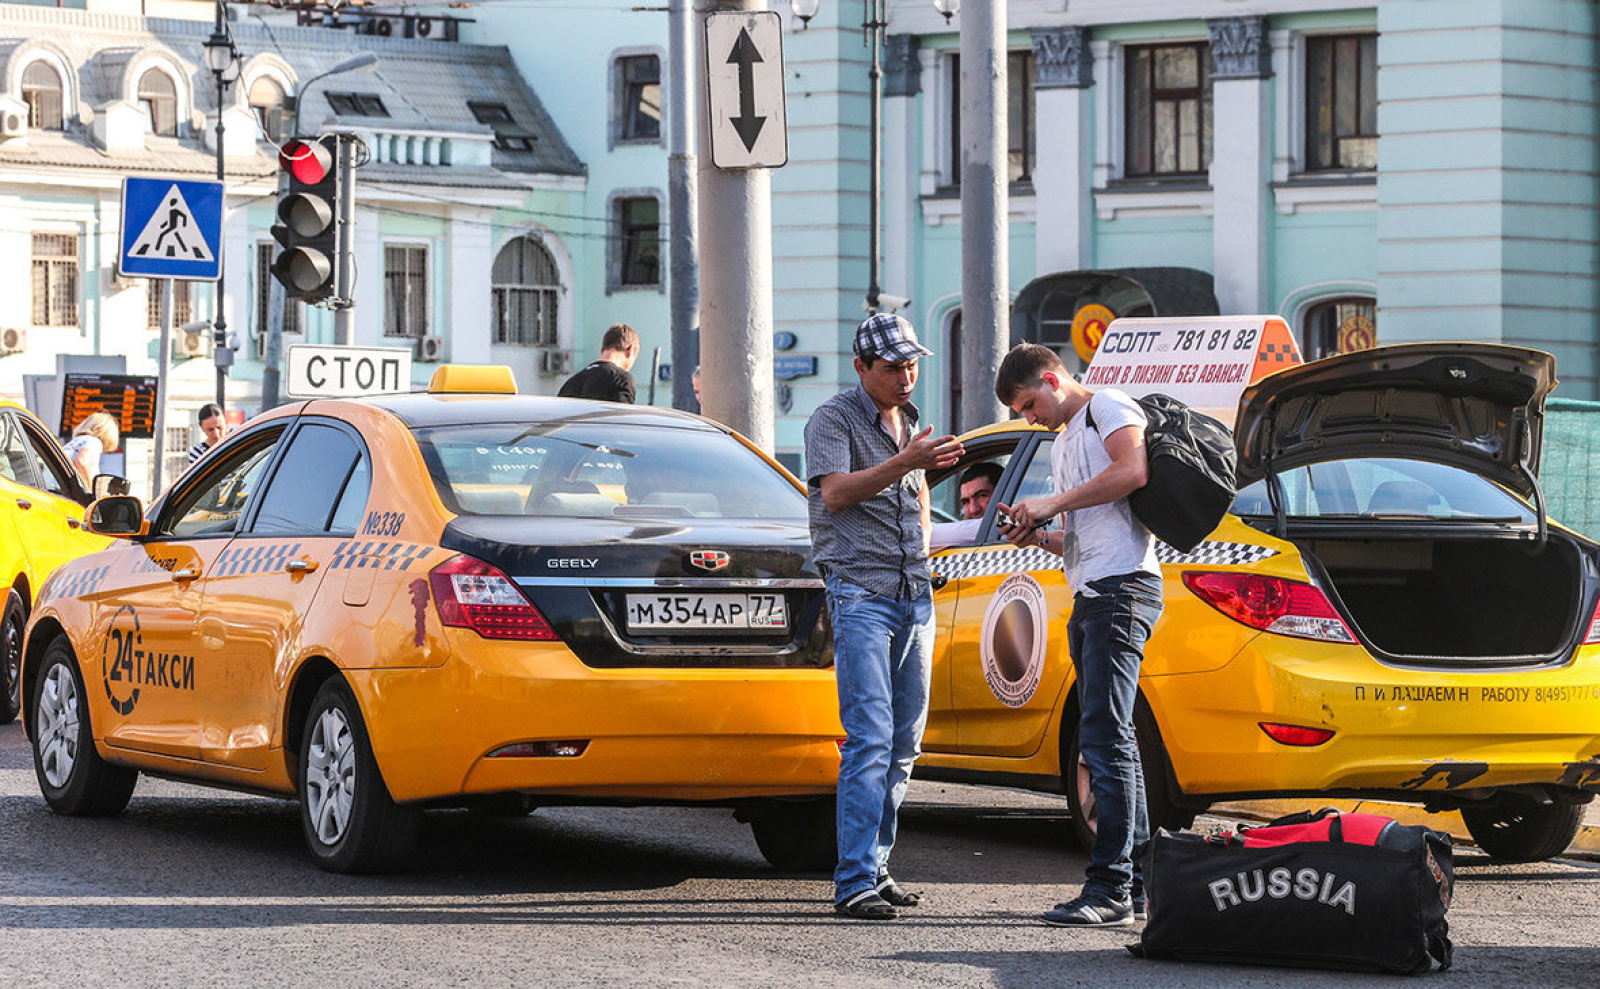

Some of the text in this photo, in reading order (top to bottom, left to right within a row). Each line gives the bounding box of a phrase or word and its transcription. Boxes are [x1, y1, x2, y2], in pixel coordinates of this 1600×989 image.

[1173, 330, 1206, 351] 781
[1207, 329, 1231, 351] 81
[1233, 329, 1257, 351] 82
[306, 355, 399, 390] СТОП
[1085, 363, 1249, 385] ТАКСИ В ЛИЗИНГ БЕЗ АВАНСА!
[362, 511, 406, 536] №338
[547, 558, 599, 569] GEELY
[636, 596, 777, 624] М354АР 77
[751, 617, 771, 626] RUS
[110, 628, 195, 691] 24 ТАКСИ
[1208, 866, 1357, 915] RUSSIA
